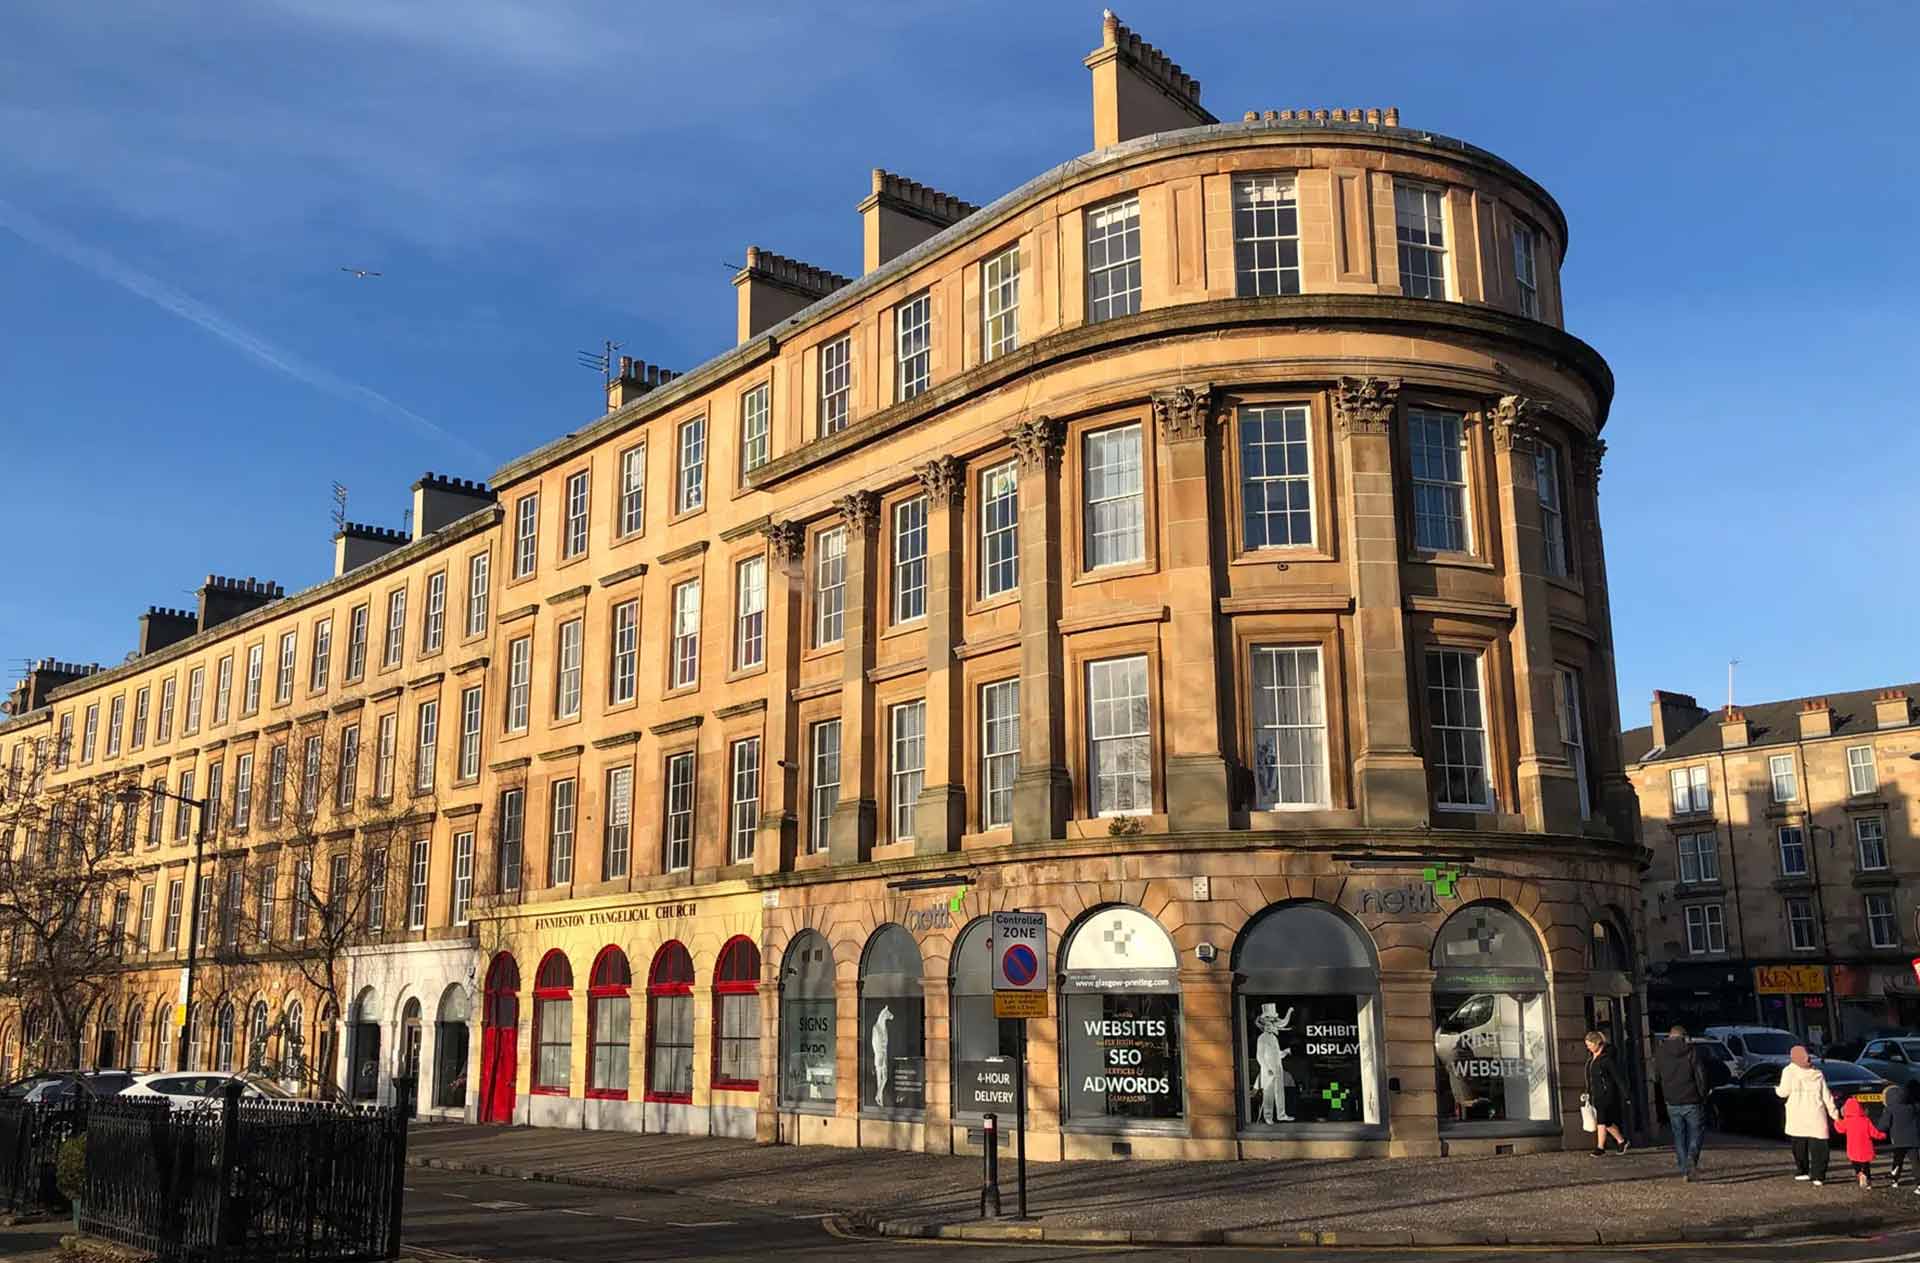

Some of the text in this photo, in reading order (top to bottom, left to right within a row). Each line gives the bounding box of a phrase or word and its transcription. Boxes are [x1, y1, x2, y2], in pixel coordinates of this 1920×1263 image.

[1359, 881, 1440, 914] nettl
[535, 903, 697, 930] FINNIESTON EVANGELICAL CHURCH
[996, 914, 1043, 925] Controlled
[1003, 927, 1037, 938] ZONE
[799, 1017, 828, 1032] SIGNS
[1084, 1020, 1166, 1036] WEBSITES
[1306, 1025, 1358, 1037] EXHIBIT
[1306, 1043, 1360, 1055] DISPLAY
[1109, 1048, 1142, 1065] SEO
[977, 1072, 1010, 1085] 4-HOUR
[1083, 1076, 1169, 1094] ADWORDS
[975, 1090, 1014, 1103] DELIVERY
